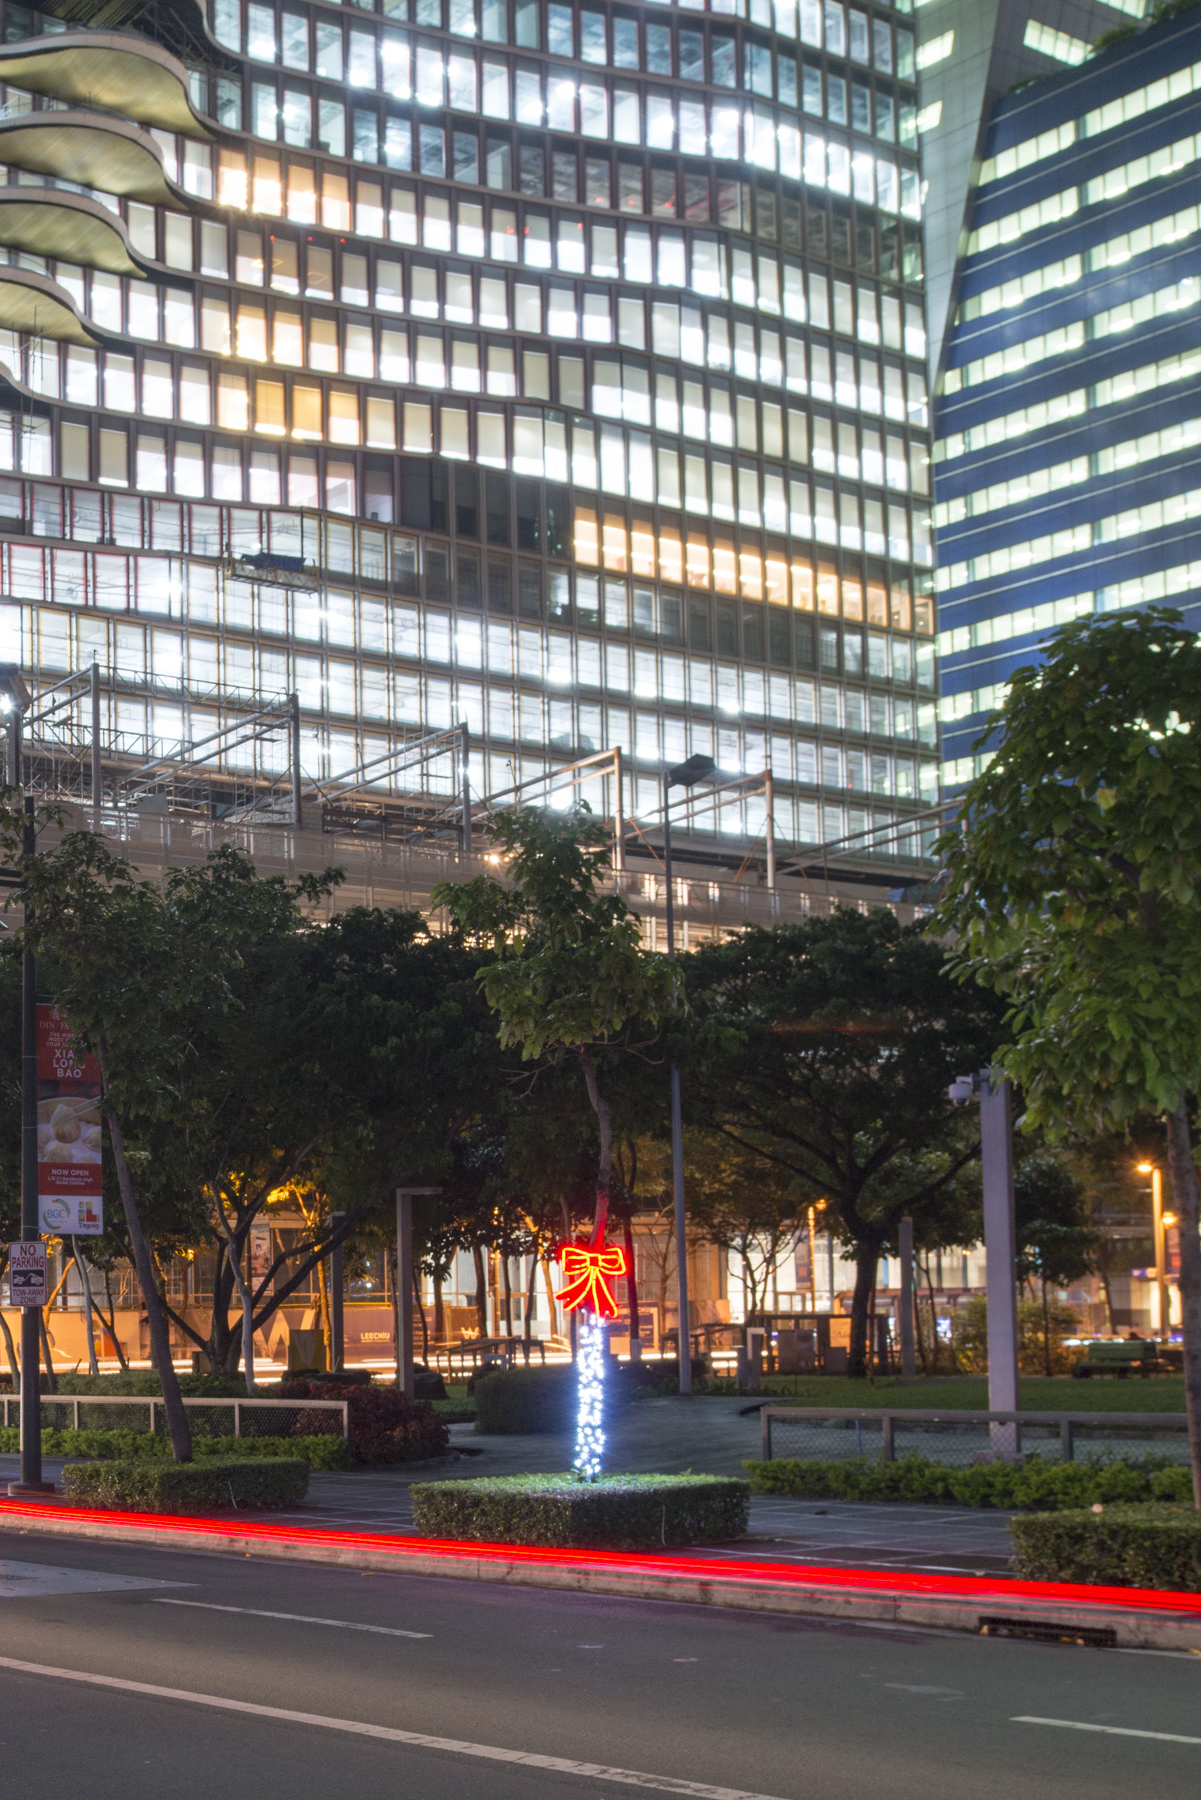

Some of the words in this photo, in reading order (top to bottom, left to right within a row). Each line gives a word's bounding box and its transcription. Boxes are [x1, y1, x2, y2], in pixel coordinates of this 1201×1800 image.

[55, 1049, 74, 1059] XIA
[57, 1068, 82, 1078] BAO
[47, 1209, 65, 1219] BGC
[20, 1244, 36, 1256] NO
[11, 1256, 44, 1268] PARKING
